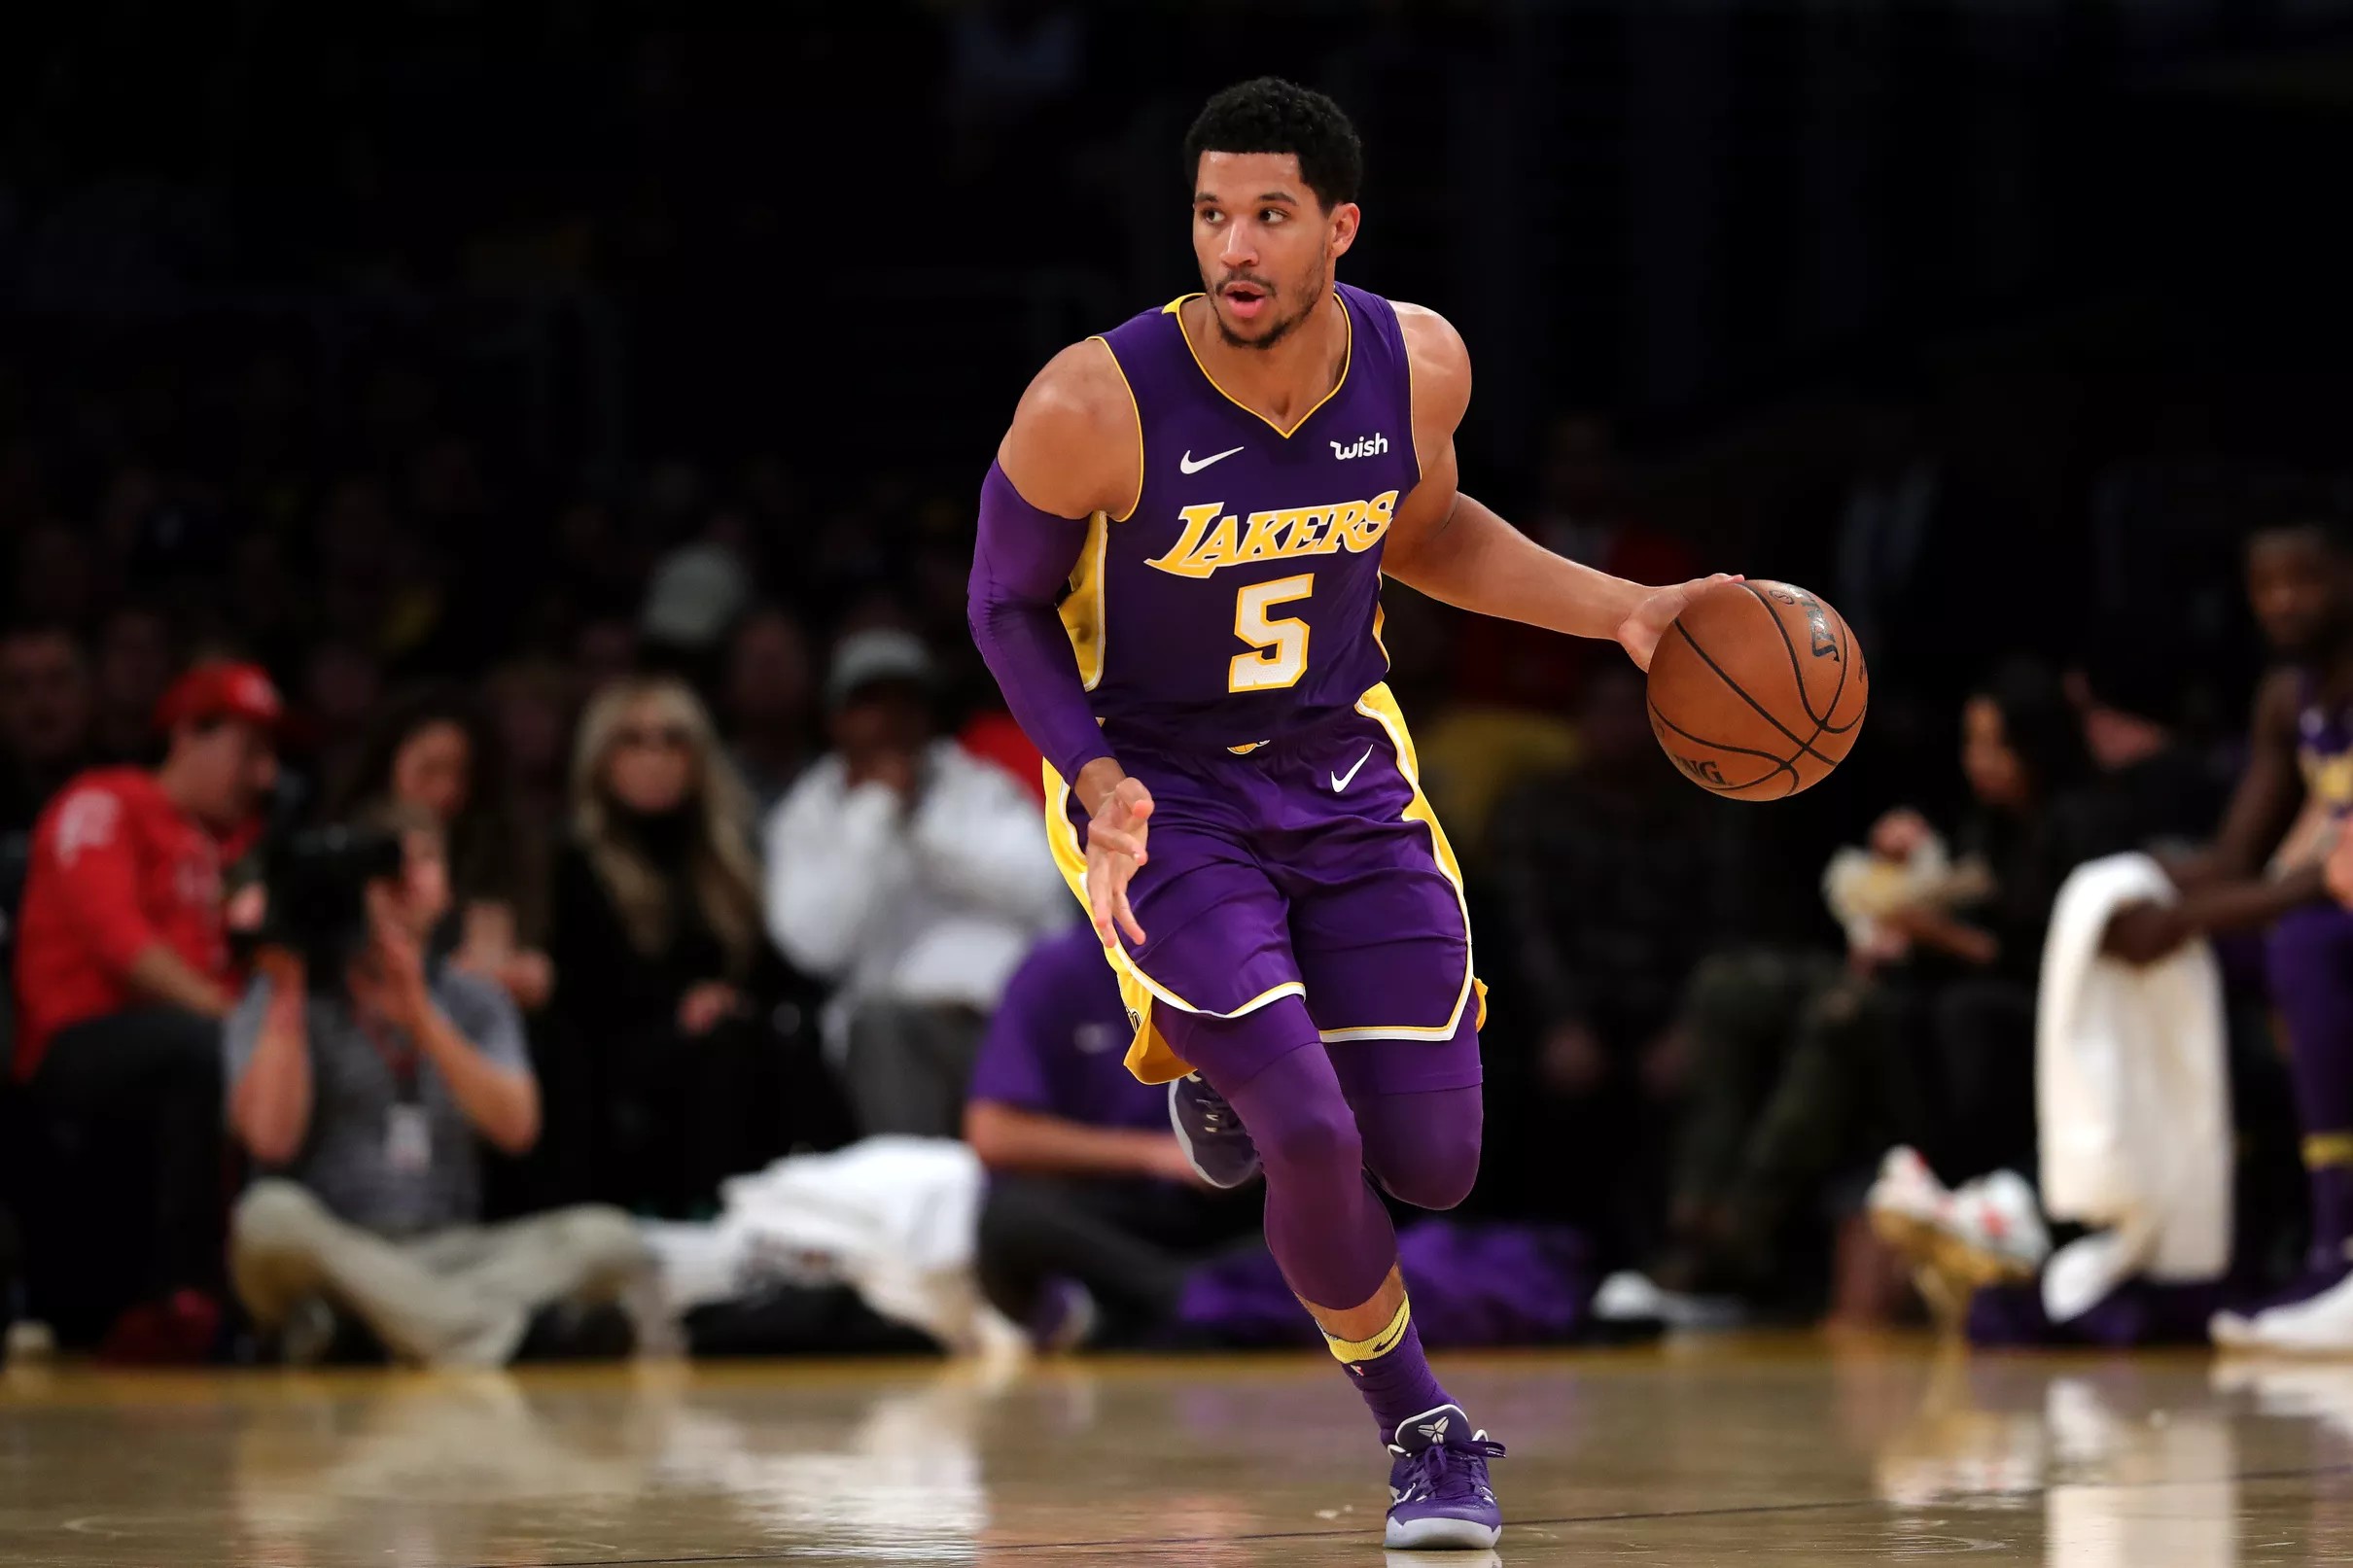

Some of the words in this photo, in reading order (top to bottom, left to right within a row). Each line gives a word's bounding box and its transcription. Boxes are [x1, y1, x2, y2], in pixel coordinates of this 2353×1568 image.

[1330, 433, 1388, 460] wish
[1143, 491, 1400, 578] LAKERS
[1229, 573, 1315, 693] 5
